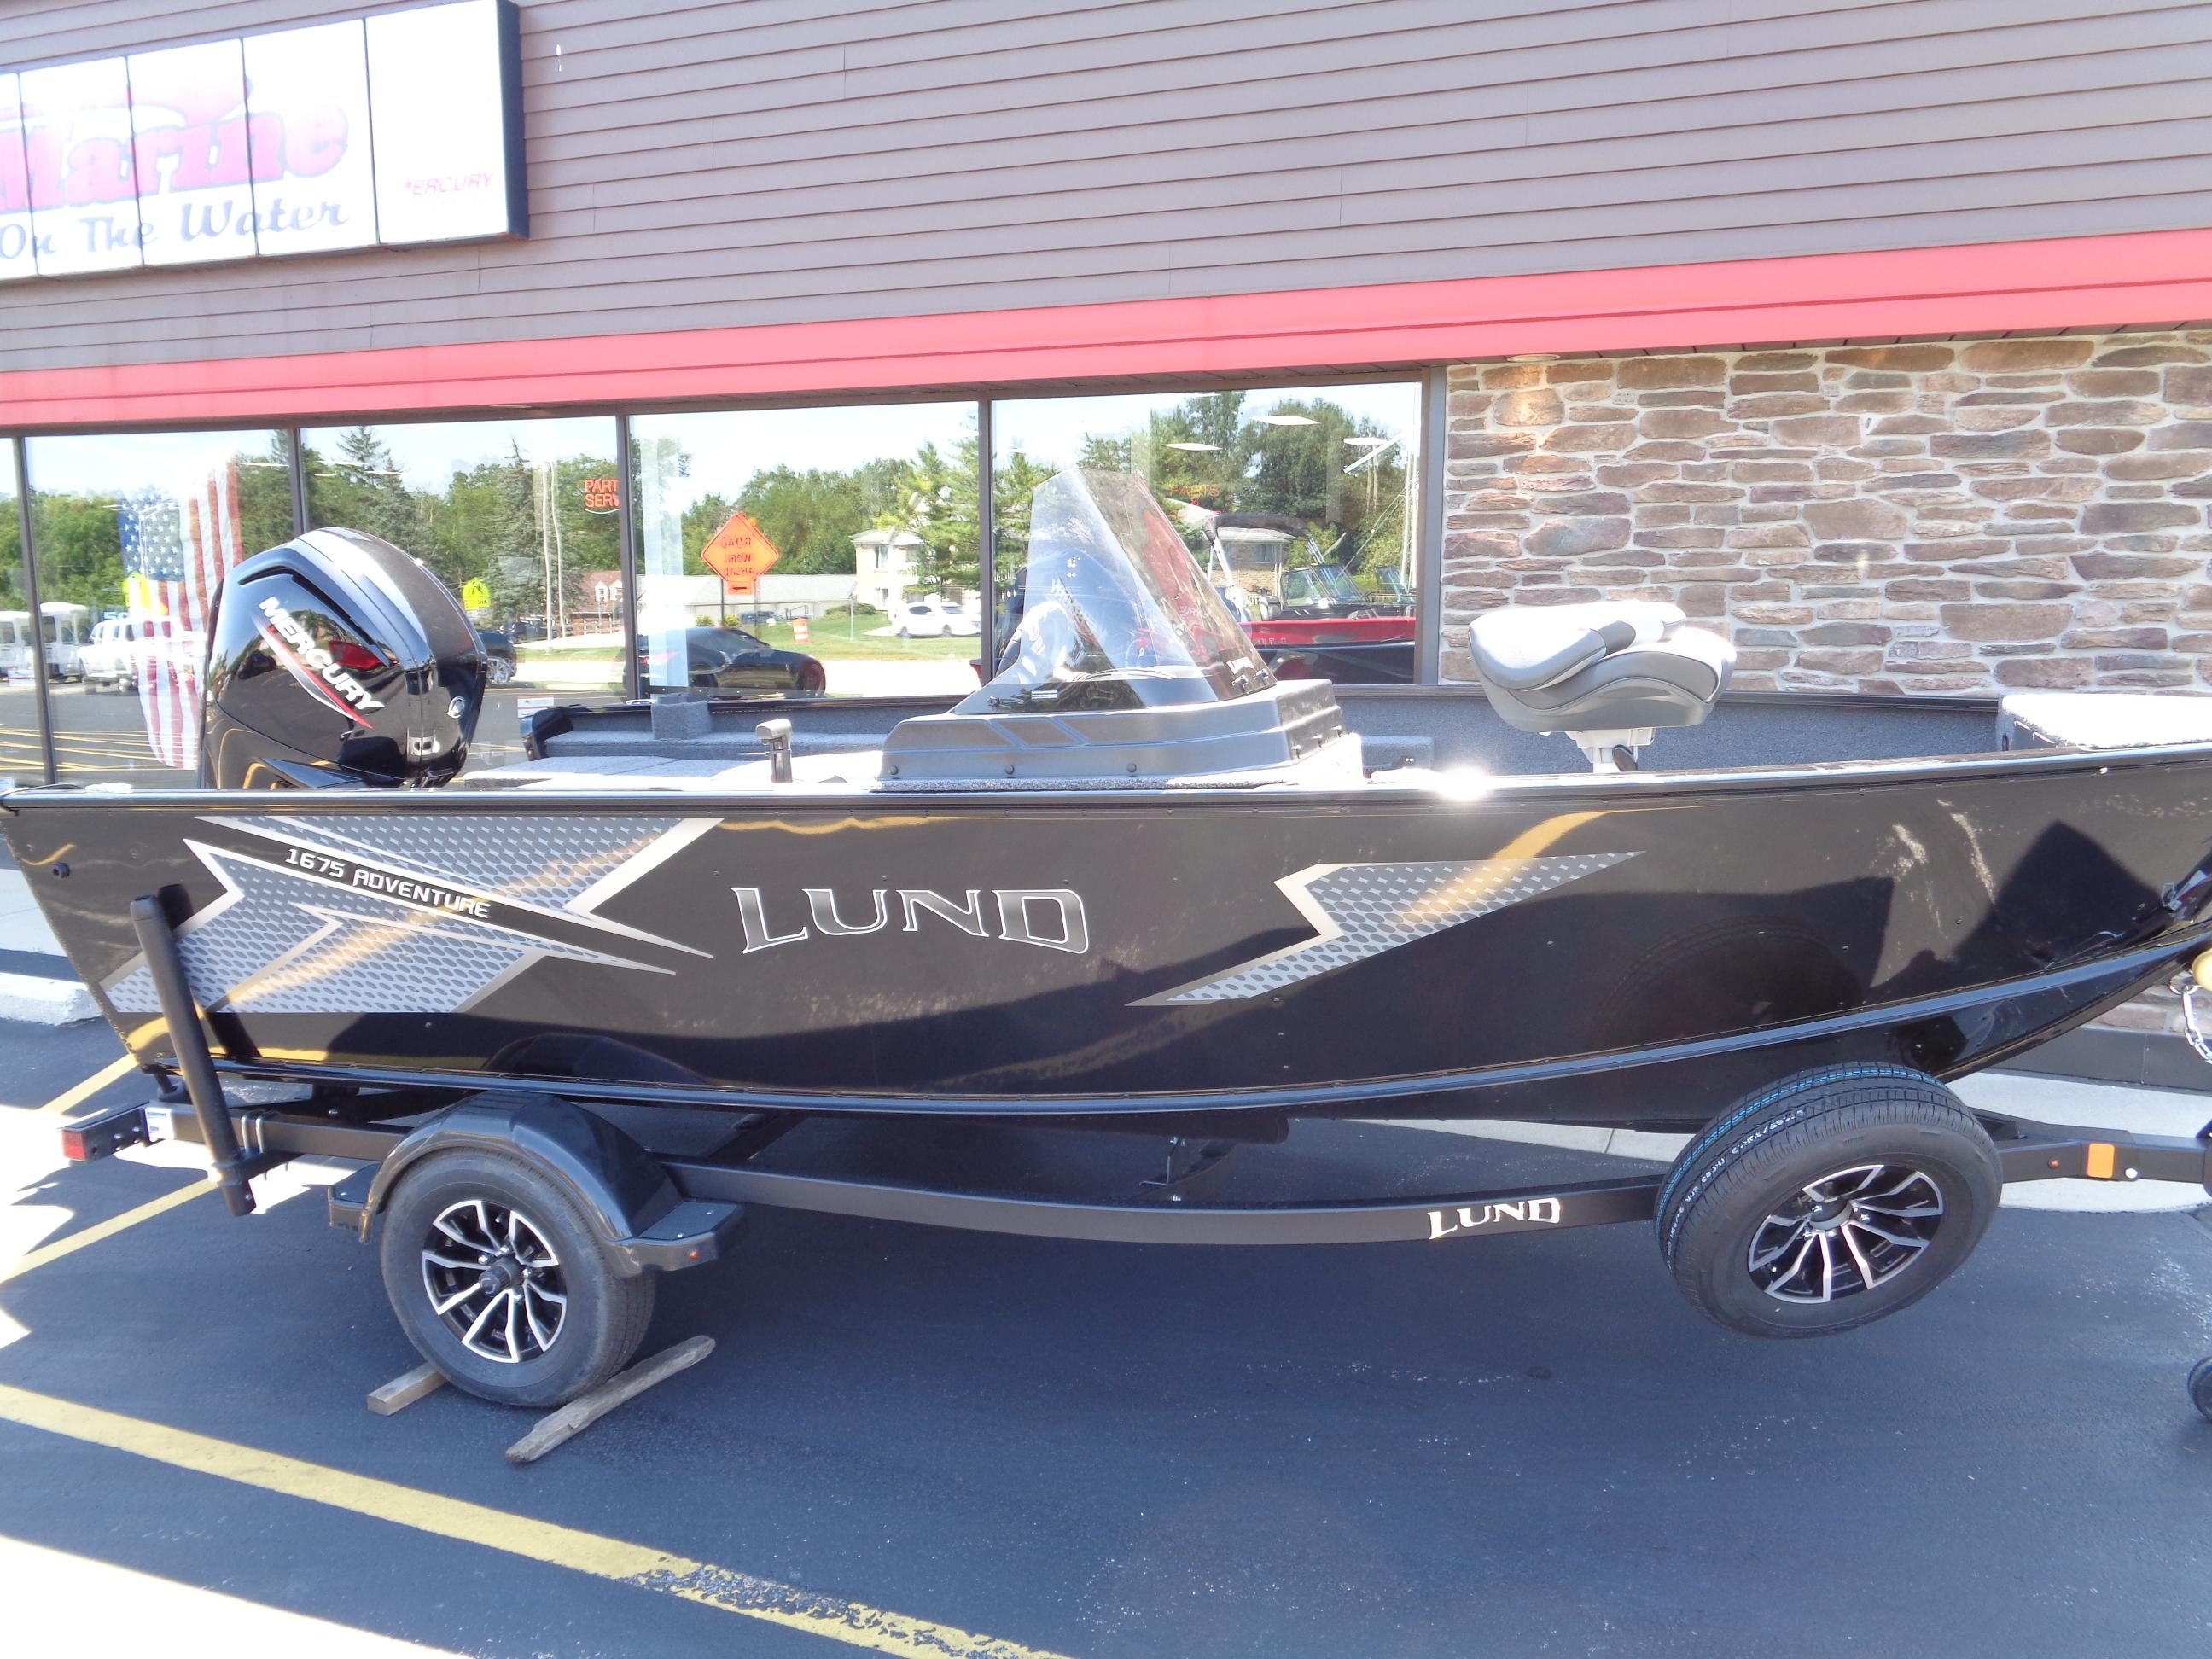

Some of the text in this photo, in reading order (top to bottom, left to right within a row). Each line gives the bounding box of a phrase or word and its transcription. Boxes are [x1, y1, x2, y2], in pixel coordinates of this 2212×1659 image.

[405, 172, 493, 195] ERCURY
[79, 216, 160, 253] The
[181, 198, 350, 241] Water
[259, 596, 386, 710] MERCURY
[284, 848, 492, 919] 1675 ADVENTURE
[730, 887, 1089, 954] LUND
[1427, 1197, 1561, 1240] LUND
